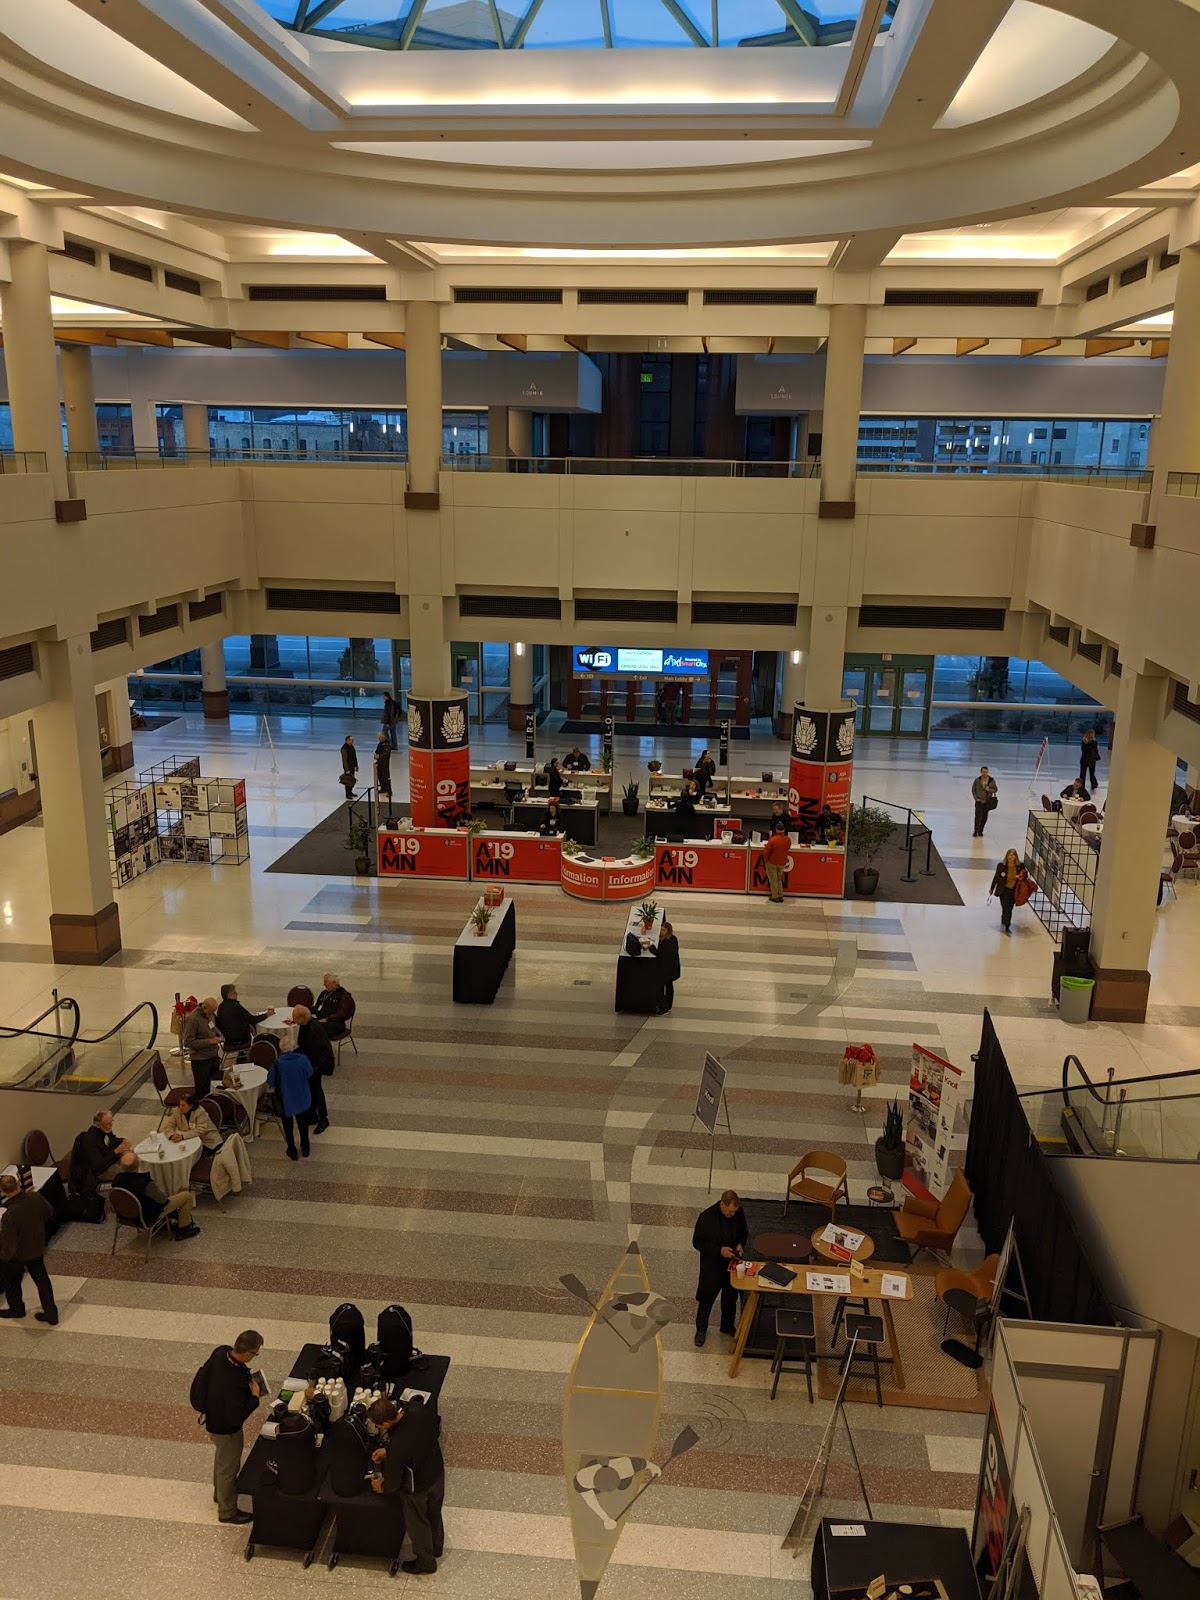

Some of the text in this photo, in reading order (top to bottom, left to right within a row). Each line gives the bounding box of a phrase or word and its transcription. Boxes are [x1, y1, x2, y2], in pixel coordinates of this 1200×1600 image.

[382, 837, 420, 855] A'19
[476, 842, 515, 860] A'19
[382, 854, 416, 871] MN
[476, 859, 510, 876] MN
[659, 850, 699, 868] A'19
[658, 867, 693, 884] MN
